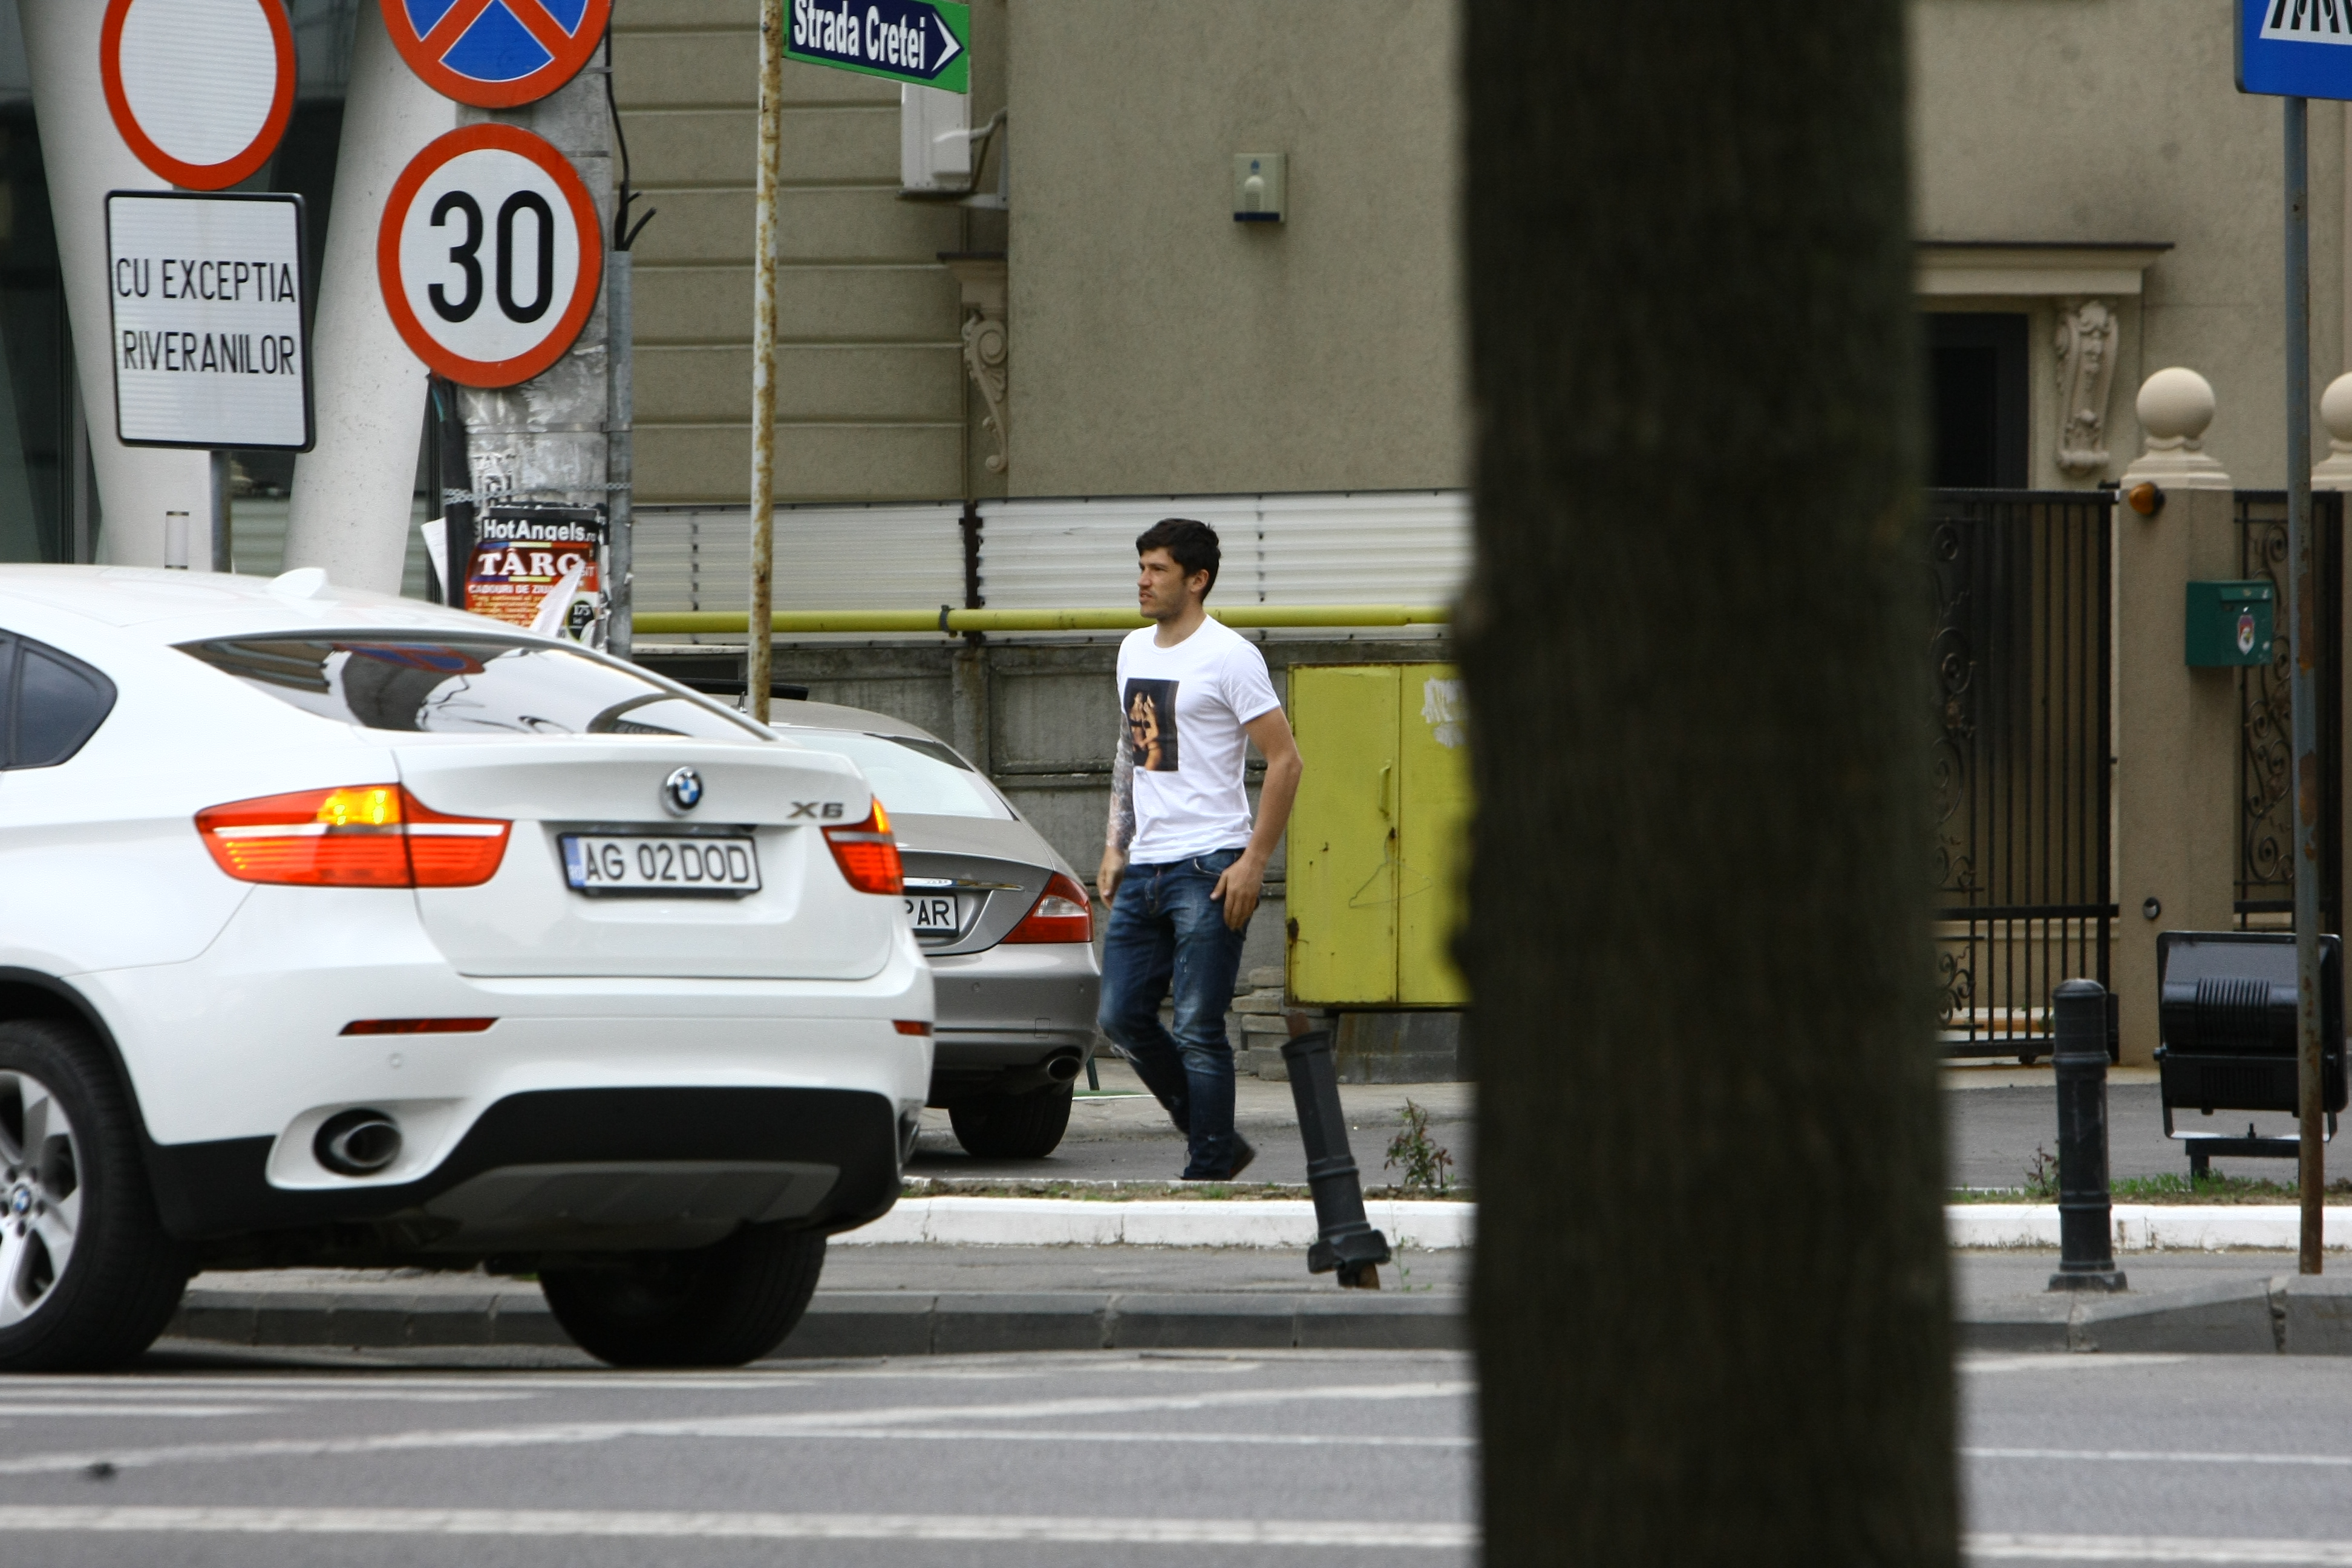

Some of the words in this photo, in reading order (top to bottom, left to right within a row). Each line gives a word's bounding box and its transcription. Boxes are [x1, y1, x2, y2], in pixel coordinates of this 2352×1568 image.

[794, 0, 860, 56] Strada
[865, 5, 926, 70] Cretei
[428, 190, 554, 323] 30
[117, 257, 149, 298] CU
[163, 260, 296, 304] EXCEPTIA
[123, 330, 295, 376] RIVERANILOR
[787, 802, 844, 819] X6
[586, 842, 624, 881] AG
